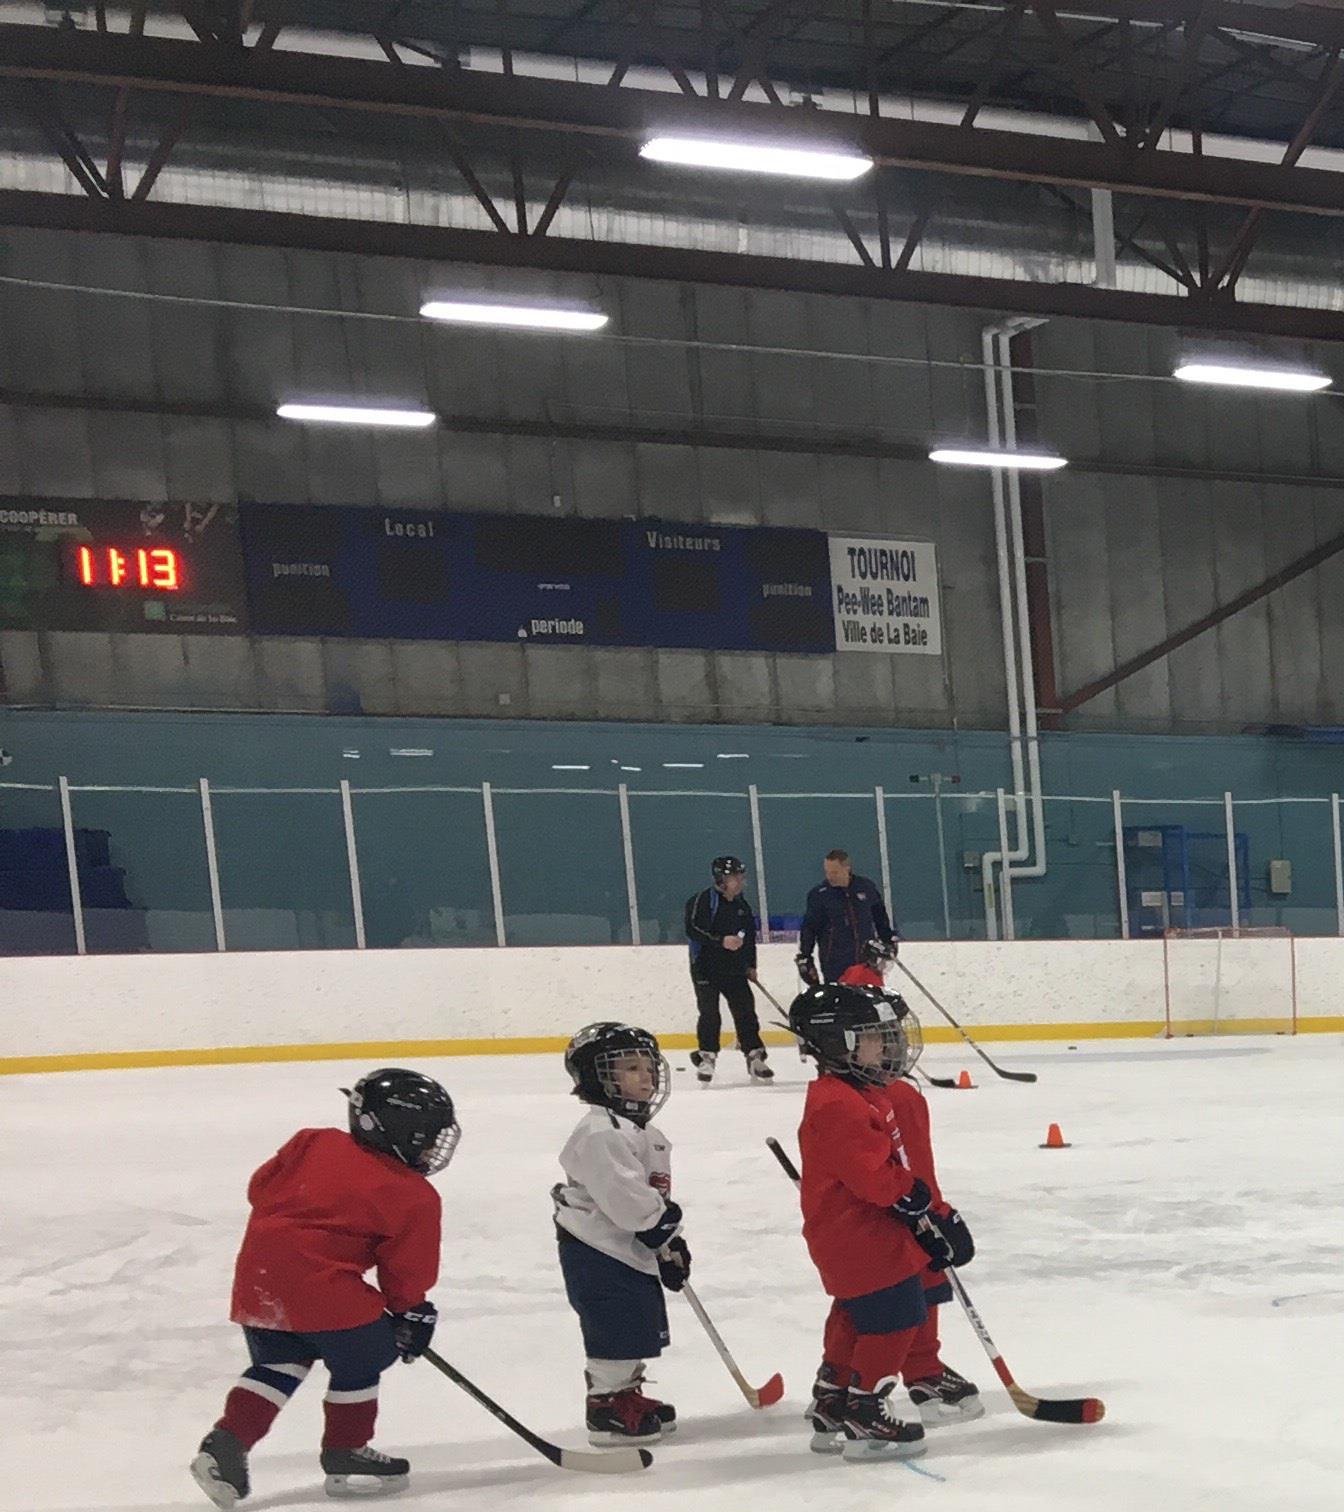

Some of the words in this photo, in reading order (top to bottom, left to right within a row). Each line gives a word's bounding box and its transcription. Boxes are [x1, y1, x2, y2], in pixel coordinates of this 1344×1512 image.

[384, 517, 435, 538] Local
[646, 531, 721, 552] Visiteurs
[80, 546, 178, 590] 11:13
[847, 546, 917, 583] TOURNOI
[836, 584, 884, 617] Pee-Wee
[886, 585, 931, 619] Bantam
[841, 619, 867, 644] Ville
[870, 623, 884, 645] de
[887, 624, 901, 645] La
[903, 624, 928, 647] Baie
